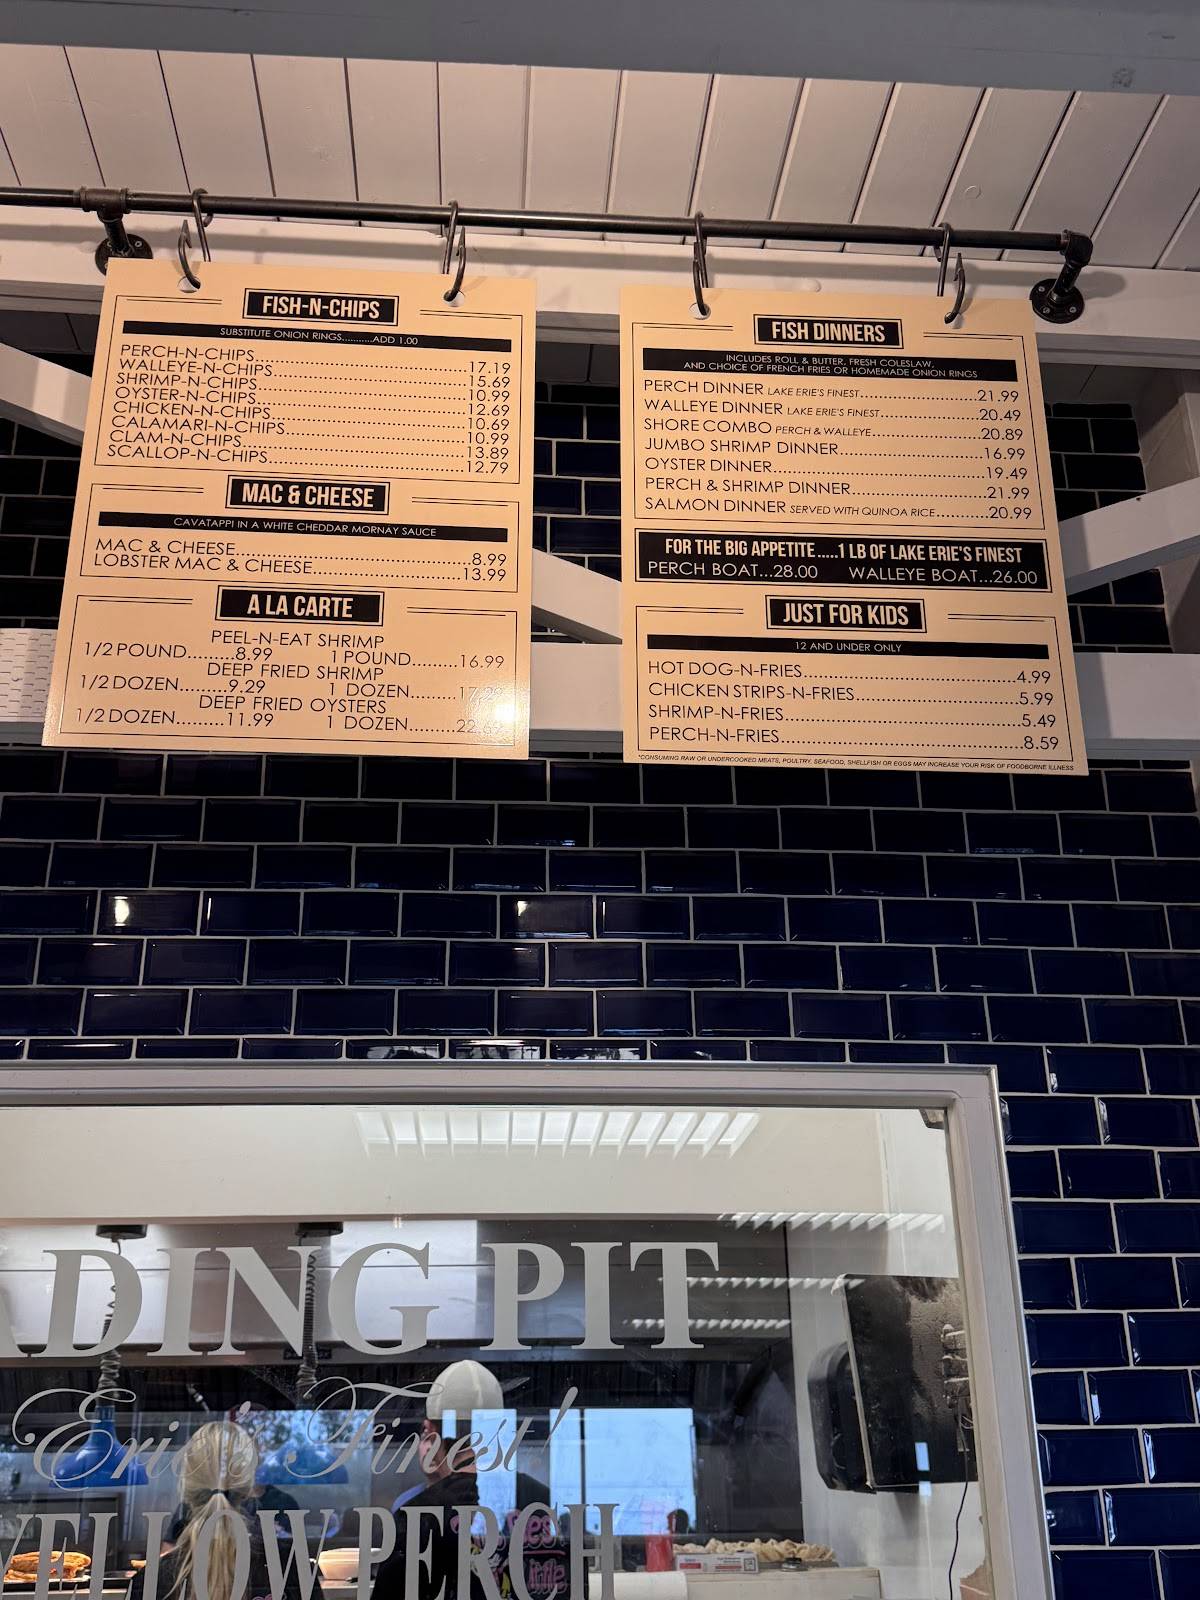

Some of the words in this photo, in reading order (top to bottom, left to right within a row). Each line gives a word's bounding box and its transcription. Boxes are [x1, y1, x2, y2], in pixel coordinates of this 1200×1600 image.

[262, 295, 380, 319] FISH-N-CHIPS
[220, 327, 271, 338] SUBSTITUTE
[274, 331, 309, 340] ONION
[312, 332, 342, 342] RINGS
[373, 335, 396, 344] ADD
[399, 337, 418, 345] 1.00
[771, 321, 808, 340] FISH
[813, 322, 886, 342] DINNERS
[120, 344, 254, 362] PERCH-N-CHIPS
[470, 361, 510, 374] 17.19
[684, 362, 706, 370] AND
[708, 363, 748, 372] CHOICE
[766, 364, 805, 373] FRENCH
[807, 365, 830, 374] FRIES
[851, 367, 910, 376] HOMEMADE
[912, 368, 946, 377] ONION
[949, 370, 978, 378] RINGS
[726, 354, 772, 364] INCLUDES
[849, 358, 876, 366] FRESH
[119, 358, 272, 376] WALLEYE-N-CHIPS
[470, 375, 510, 388] 15.69
[116, 372, 256, 390] SHRIMP-N-CHIPS
[469, 389, 510, 402] 10.99
[644, 379, 698, 393] PERCH
[703, 381, 764, 395] DINNER
[767, 387, 794, 396] LAKE
[796, 388, 824, 397] ERIE'S
[827, 388, 861, 398] FINEST
[977, 389, 1019, 402] 21.99
[115, 386, 256, 404] OYSTER-N-CHIPS
[468, 403, 510, 416] 12.69
[644, 399, 718, 414] WALLEYE
[722, 401, 782, 415] DINNER
[787, 406, 813, 416] LAKE
[815, 407, 844, 417] ERIE'S
[847, 408, 880, 418] FINEST
[979, 408, 1021, 422] 20.49
[113, 401, 270, 420] CHICKEN-N-CHIPS
[468, 417, 510, 430] 10.69
[111, 415, 285, 434] CALAMARI-N-CHIPS
[468, 432, 509, 445] 10.99
[644, 418, 700, 432] SHORE
[702, 420, 772, 434] COMBO
[775, 425, 811, 435] PERCH
[823, 427, 872, 437] WALLEYE
[980, 427, 1024, 440] 20.89
[109, 430, 242, 448] CLAM-N-CHIPS
[467, 446, 509, 460] 13.89
[644, 437, 705, 451] JUMBO
[710, 439, 771, 453] SHRIMP
[777, 441, 838, 455] DINNER
[984, 447, 1026, 460] 16.99
[107, 444, 268, 464] SCALLOP-N-CHIPS
[467, 460, 508, 474] 12.79
[645, 457, 706, 471] OYSTER
[710, 459, 772, 472] DINNER
[986, 466, 1028, 480] 19.49
[242, 482, 283, 504] MAC
[287, 484, 301, 504] &
[305, 485, 374, 508] CHEESE
[645, 477, 701, 491] PERCH
[722, 479, 784, 492] SHRIMP
[788, 481, 850, 494] DINNER
[986, 486, 1030, 500] 21.99
[645, 497, 719, 512] SALMON
[724, 499, 786, 513] DINNER
[789, 505, 831, 514] SERVED
[833, 506, 860, 516] WITH
[861, 507, 908, 518] QUINOA
[910, 508, 935, 518] RICE
[988, 506, 1032, 520] 20.99
[173, 517, 234, 528] CAVATAPPI
[262, 521, 294, 532] WHITE
[296, 522, 348, 534] CHEDDAR
[351, 524, 399, 535] MORNAY
[401, 526, 436, 537] SAUCE
[96, 538, 143, 552] MAC
[167, 540, 236, 556] CHEESE
[472, 552, 507, 566] 8.99
[665, 538, 692, 554] FOR
[695, 539, 722, 556] THE
[725, 540, 748, 556] BIG
[751, 540, 816, 558] APPETITE
[849, 543, 866, 559] LB
[869, 544, 886, 560] OF
[890, 545, 925, 561] LAKE
[928, 545, 972, 562] ERIE'S
[975, 546, 1022, 563] FINEST
[94, 553, 170, 568] LOBSTER
[174, 557, 221, 571] MAC
[245, 559, 312, 575] CHEESE
[464, 567, 506, 582] 13.99
[648, 561, 705, 576] PERCH
[712, 562, 758, 577] BOAT
[773, 564, 818, 578] 28.00
[849, 566, 926, 582] WALLEYE
[931, 568, 978, 583] BOAT
[992, 569, 1038, 584] 26.00
[246, 593, 260, 615] A
[265, 594, 288, 616] LA
[293, 595, 354, 618] CARTE
[783, 602, 824, 623] JUST
[829, 604, 864, 624] FOR
[867, 605, 909, 626] KIDS
[211, 630, 312, 646] PEEL-N-EAT
[317, 633, 384, 649] SHRIMP
[795, 641, 807, 650] 12
[809, 642, 832, 650] AND
[836, 642, 870, 652] UNDER
[873, 643, 902, 652] ONLY
[84, 641, 112, 657] 1/2
[116, 643, 187, 658] POUND
[235, 647, 272, 661] 8.99
[344, 651, 411, 666] POUND
[460, 654, 504, 669] 16.99
[207, 662, 253, 676] DEEP
[261, 663, 310, 678] FRIED
[316, 666, 384, 681] SHRIMP
[648, 660, 684, 675] HOT
[688, 662, 802, 678] DOG-N-FRIES
[1016, 670, 1051, 684] 4.99
[80, 674, 108, 690] 1/2
[113, 676, 179, 692] DOZEN
[228, 679, 266, 694] 9.29
[346, 683, 409, 698] DOZEN
[648, 682, 728, 698] CHICKEN
[733, 684, 855, 702] STRIPS-N-FRIES
[1019, 692, 1054, 706] 5.99
[199, 695, 246, 710] DEEP
[253, 696, 302, 711] FRIED
[310, 698, 386, 714] OYSTERS
[648, 704, 784, 721] SHRIMP-N-FRIES
[1021, 714, 1056, 728] 5.49
[76, 708, 104, 723] 1/2
[109, 709, 175, 725] DOZEN
[227, 712, 274, 727] 11.99
[344, 716, 408, 731] DOZEN
[649, 726, 780, 744] PERCH-N-FRIES
[1023, 735, 1059, 750] 8.59
[480, 1241, 720, 1350] PIT
[284, 1376, 578, 1478] Finest!
[353, 1501, 619, 1600] PERCH
